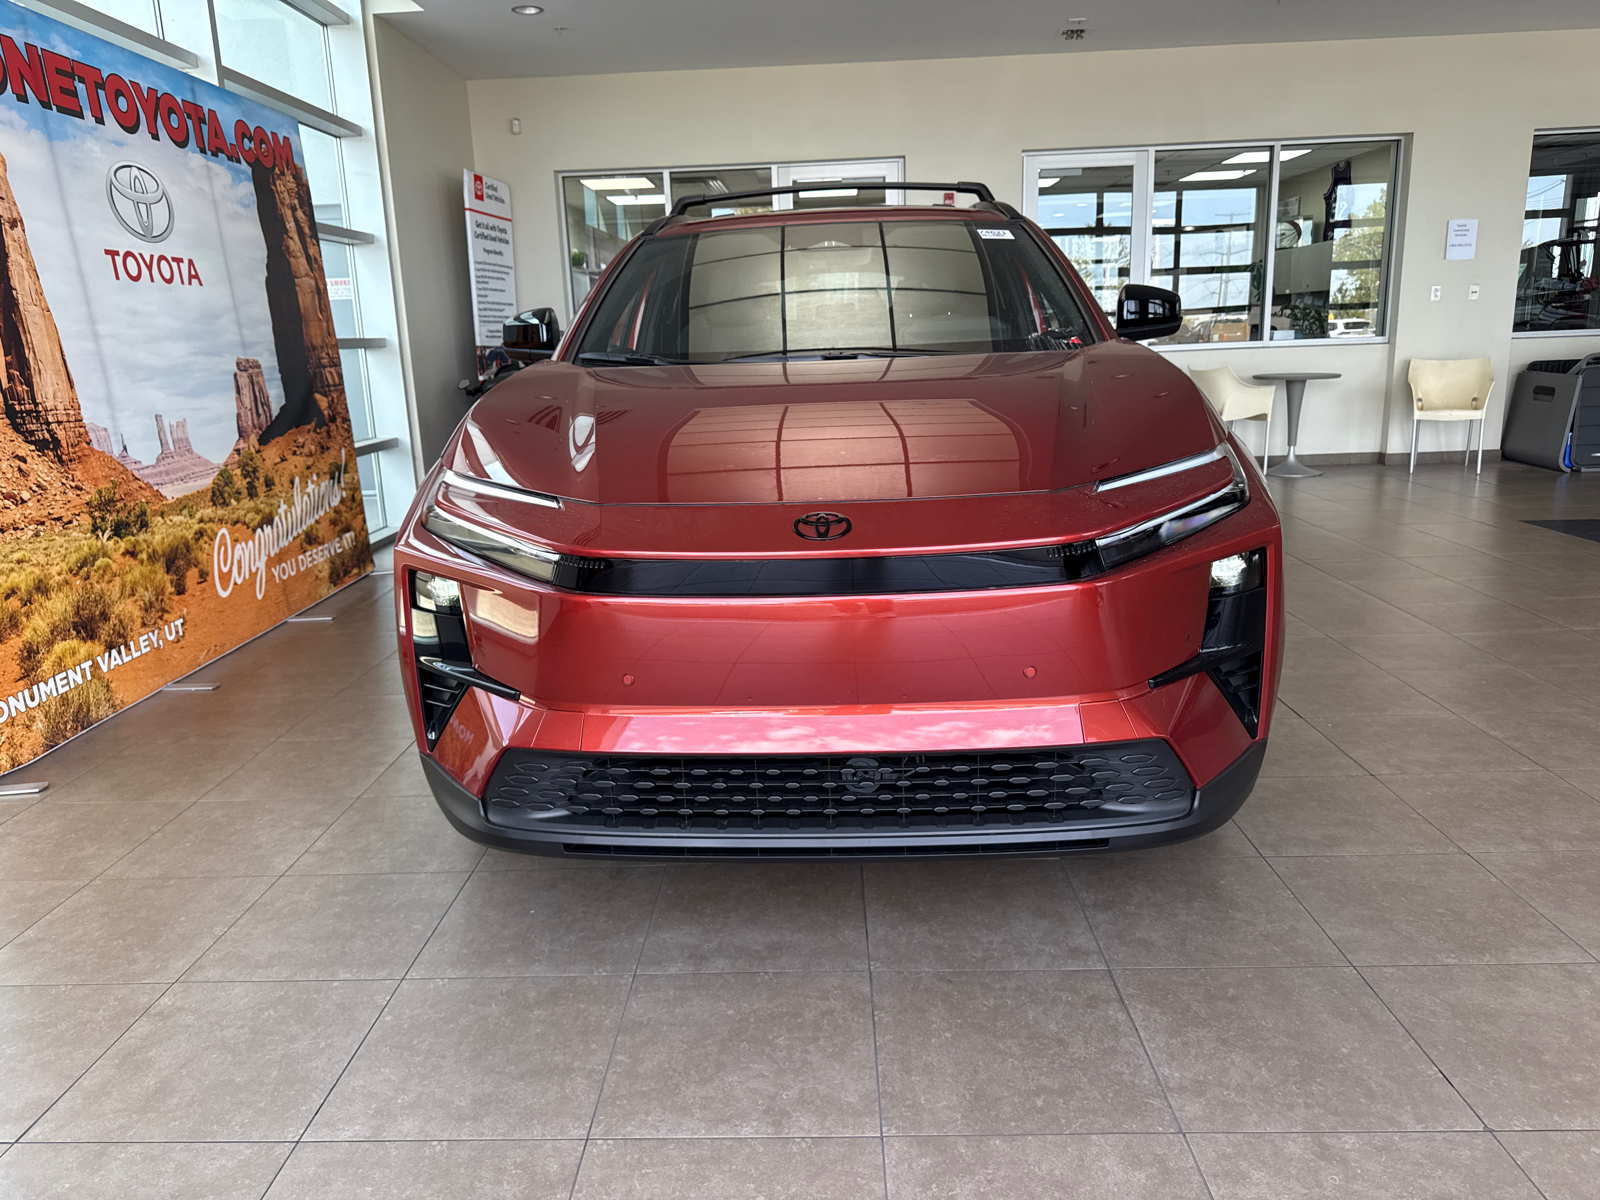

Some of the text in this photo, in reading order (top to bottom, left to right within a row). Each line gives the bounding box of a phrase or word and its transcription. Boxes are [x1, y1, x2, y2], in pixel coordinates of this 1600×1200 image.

[0, 33, 297, 176] NETOYOTA.COM
[103, 249, 203, 287] TOYOTA
[213, 447, 346, 600] Congratulations!
[271, 530, 356, 583] YOU DESERVE IT!
[96, 629, 163, 674] VALLEY,
[164, 618, 184, 642] UT
